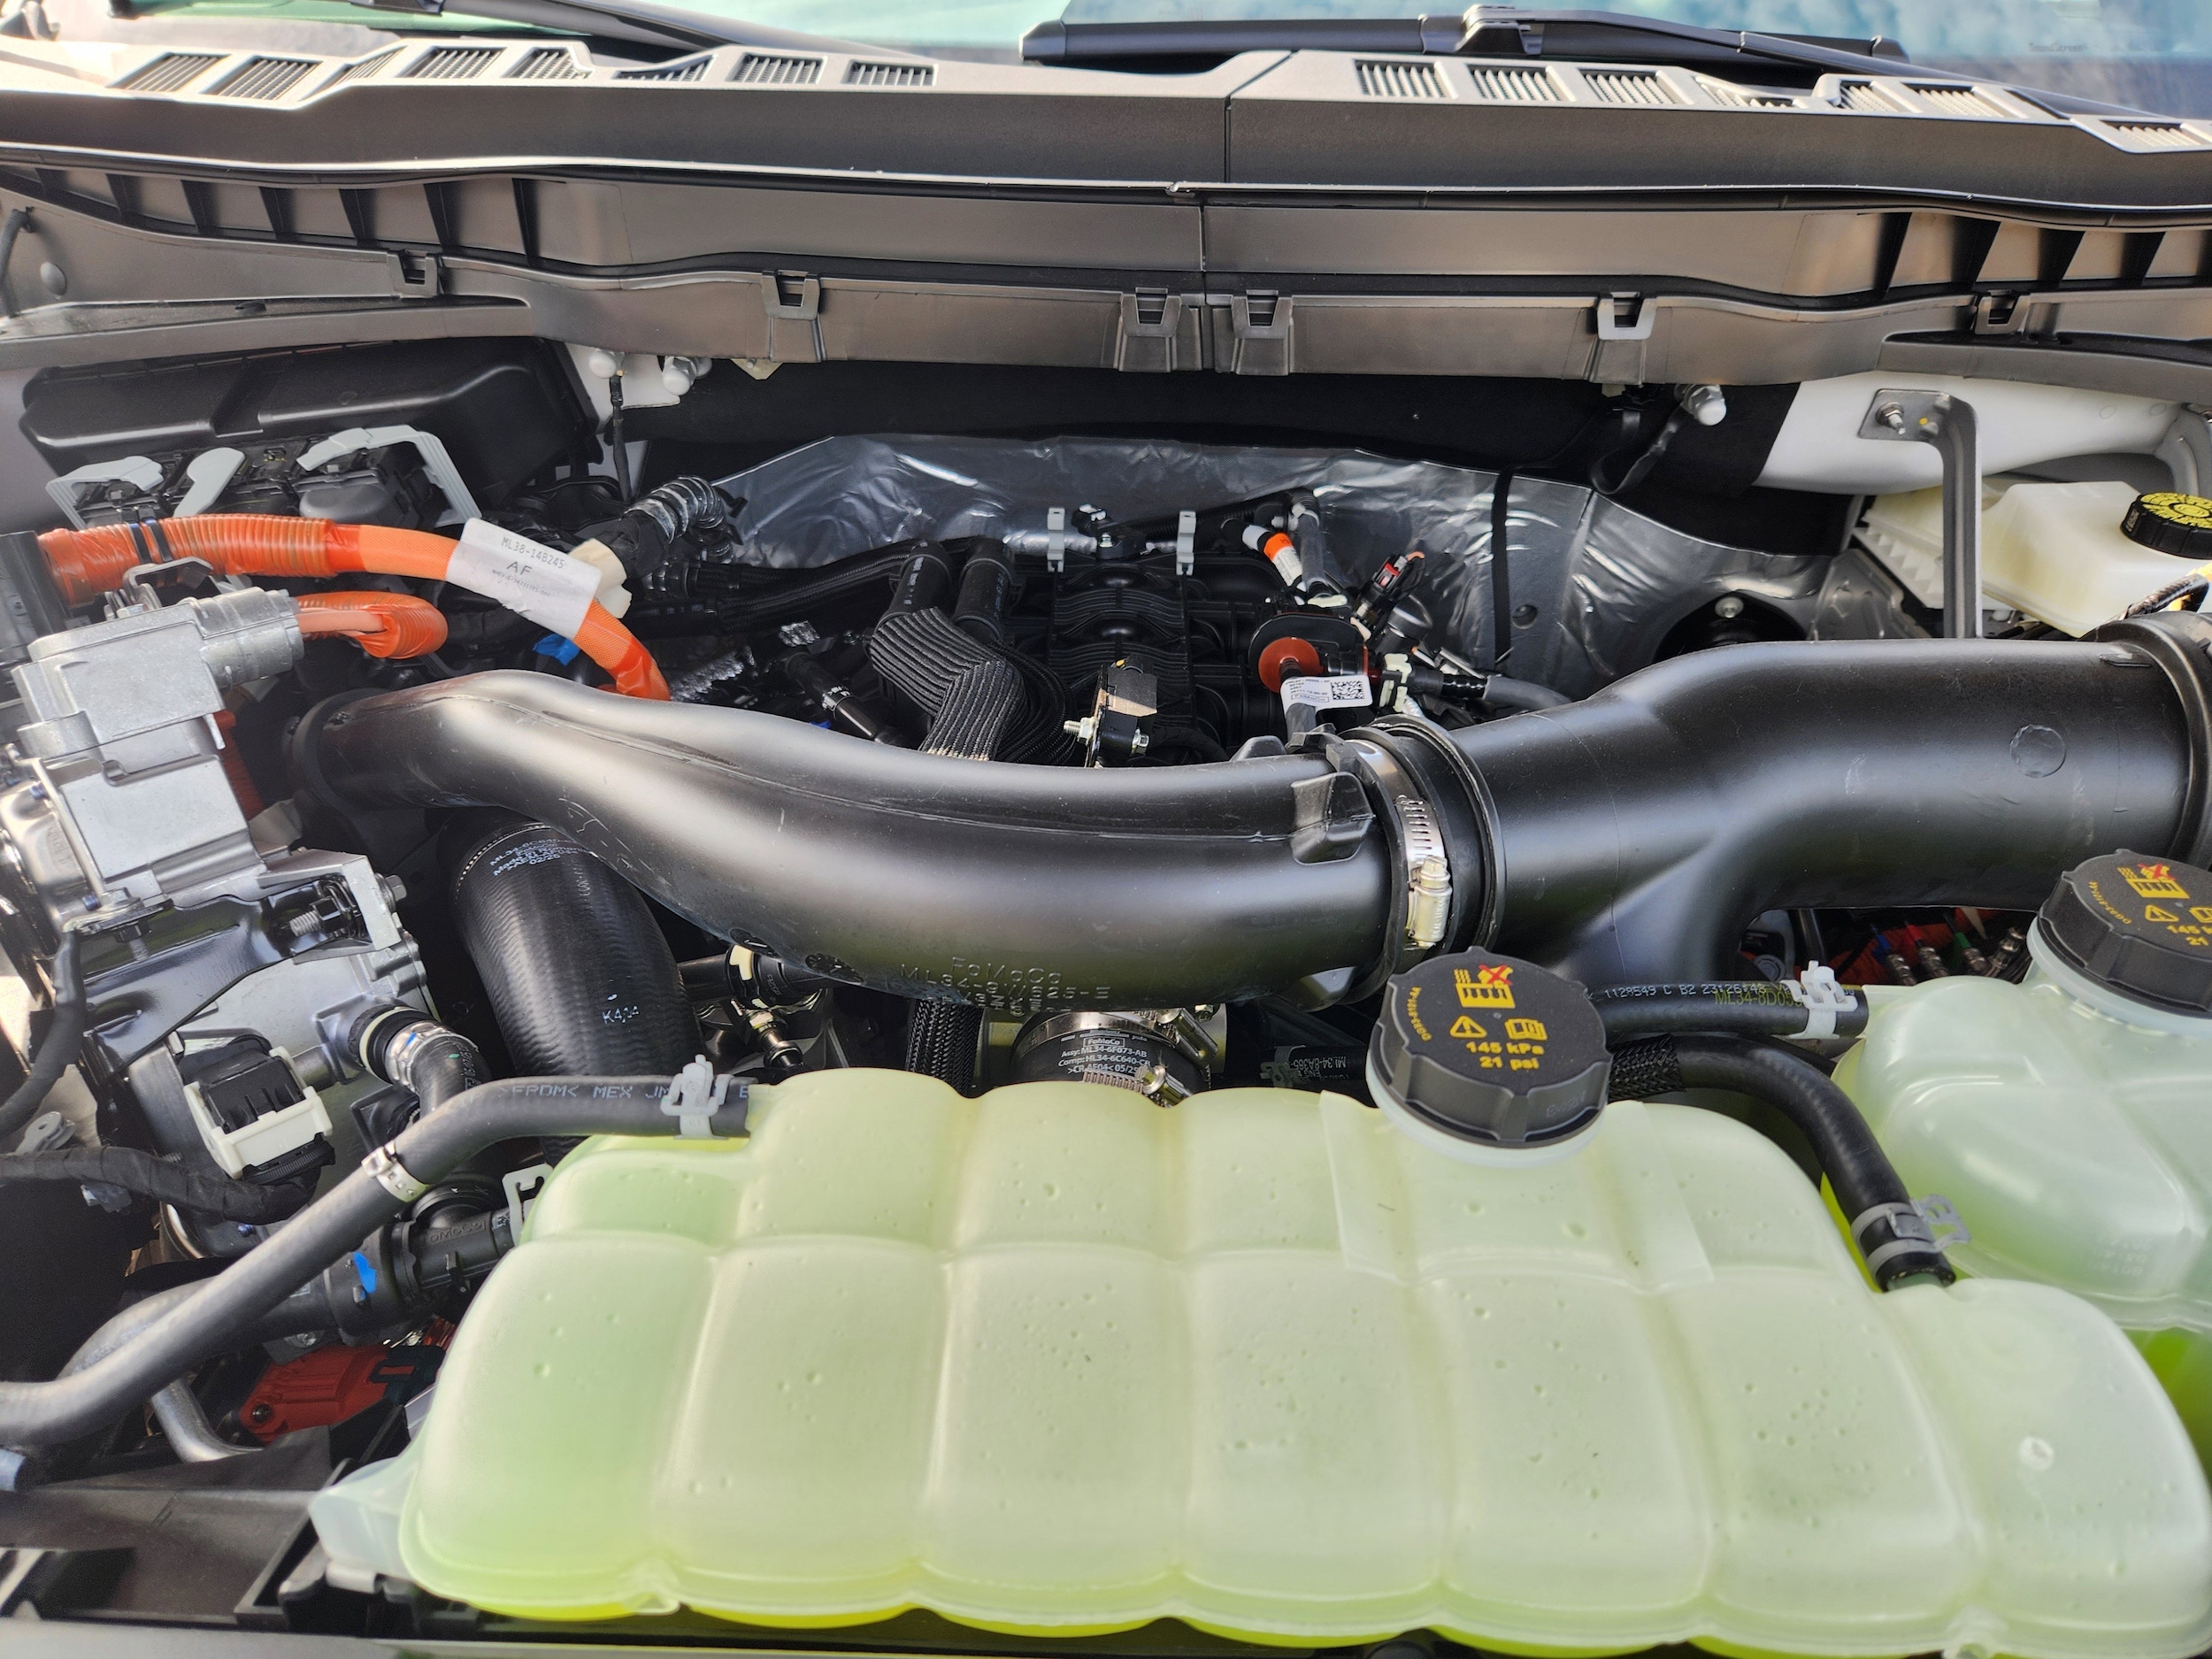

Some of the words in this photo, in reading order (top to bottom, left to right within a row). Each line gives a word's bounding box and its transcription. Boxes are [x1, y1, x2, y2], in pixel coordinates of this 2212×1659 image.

[502, 537, 565, 569] ML38-14B245
[506, 561, 533, 575] AF
[2167, 925, 2200, 934] 145
[2185, 935, 2208, 946] 21
[951, 956, 1061, 984] FoMoCo
[1062, 1049, 1080, 1058] Assy:
[1465, 1041, 1502, 1055] 145
[1506, 1042, 1545, 1055] kPa
[1058, 1056, 1086, 1067] Comp:
[1479, 1056, 1503, 1069] 21
[1509, 1056, 1540, 1071] psi
[593, 1086, 633, 1099] MEX
